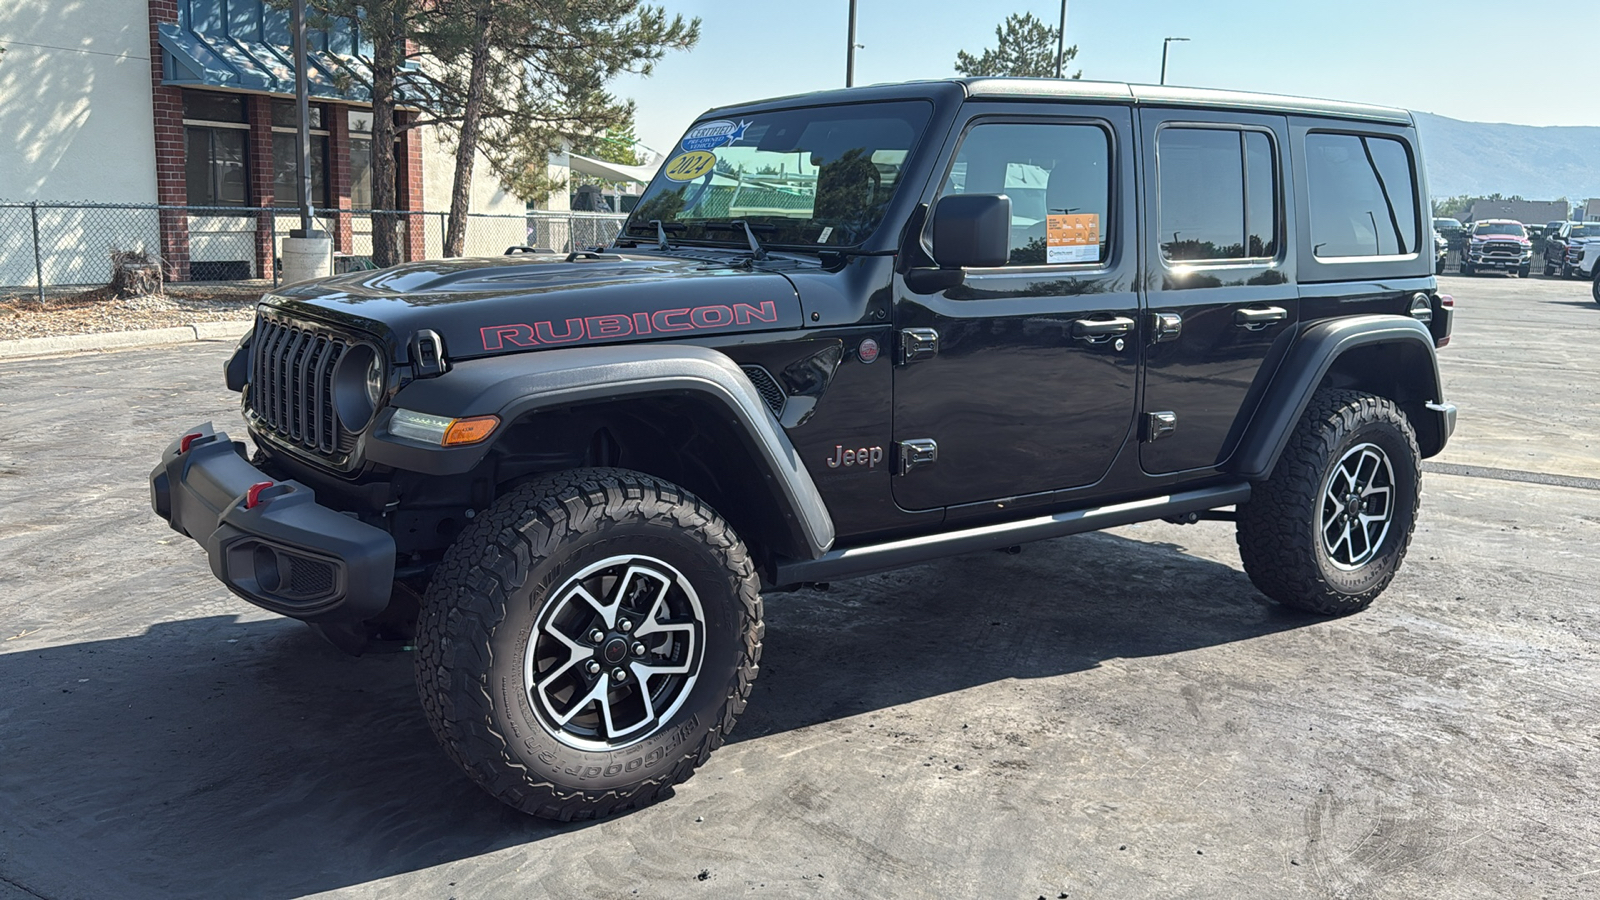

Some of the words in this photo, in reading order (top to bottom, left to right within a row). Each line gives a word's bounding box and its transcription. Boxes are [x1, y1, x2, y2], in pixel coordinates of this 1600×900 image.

[688, 136, 725, 145] PRE-OWNED
[691, 125, 732, 138] CERTIFIED
[669, 156, 713, 174] 2024
[480, 301, 778, 350] RUBICON
[826, 445, 883, 468] Jeep
[523, 713, 701, 781] BFGoodrich
